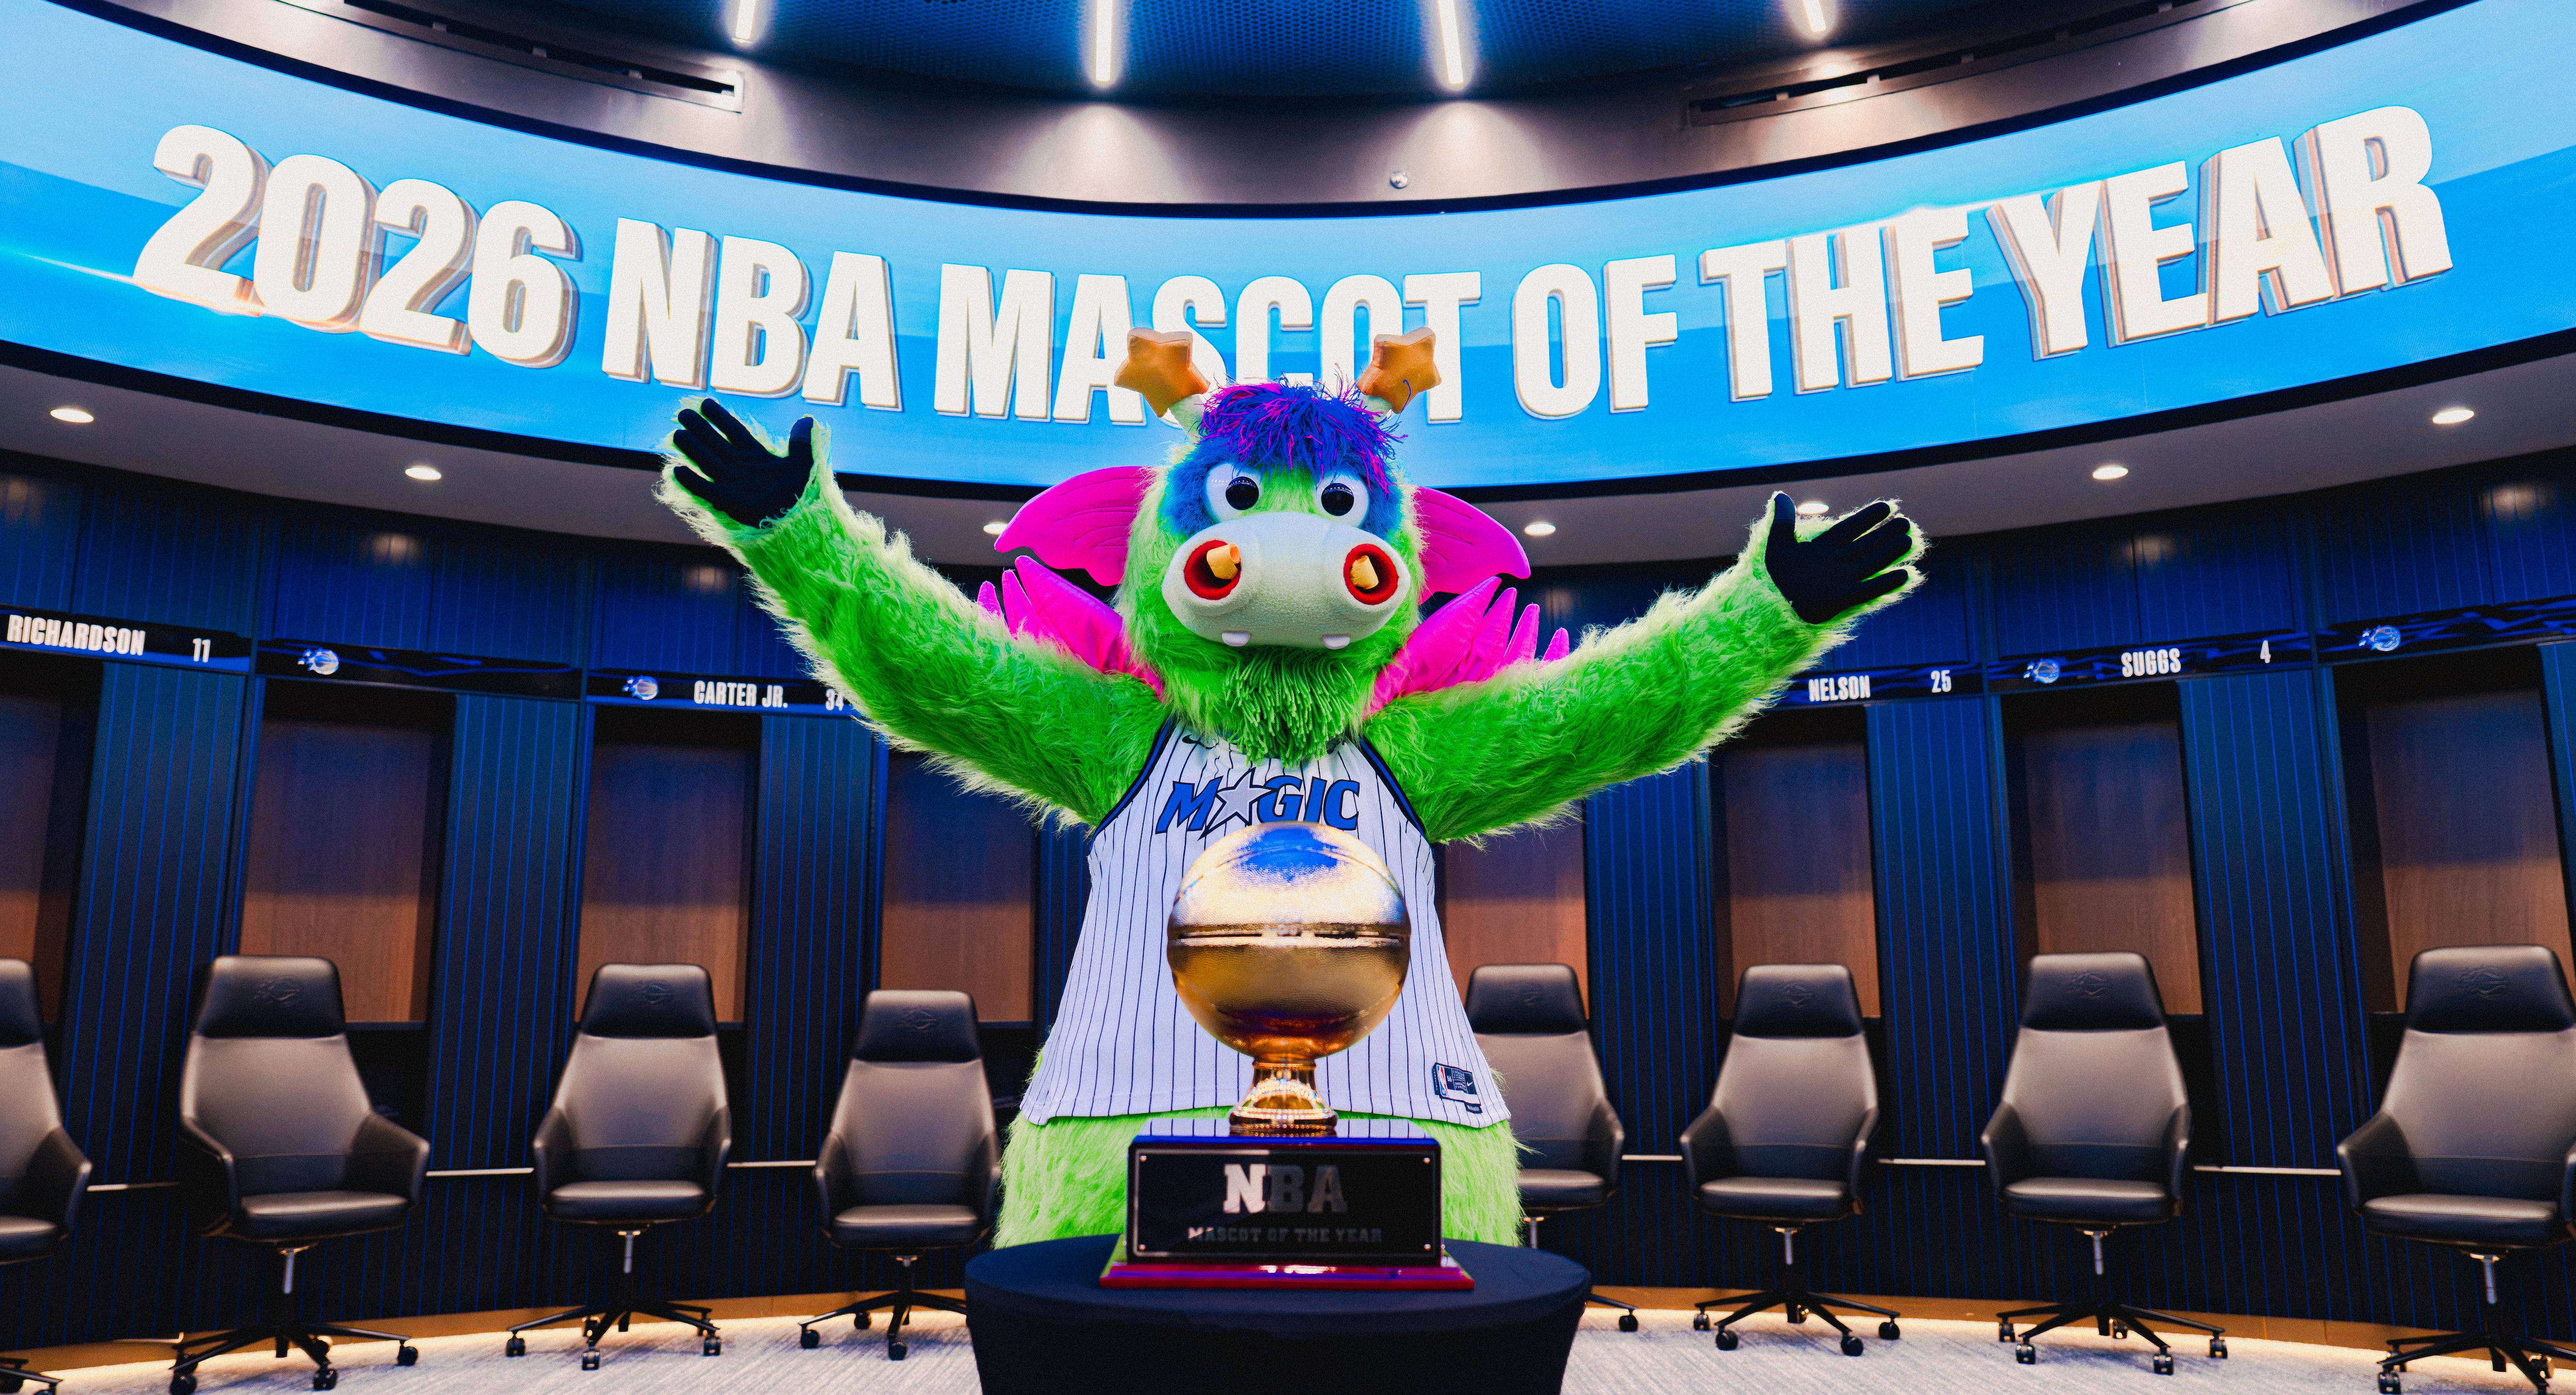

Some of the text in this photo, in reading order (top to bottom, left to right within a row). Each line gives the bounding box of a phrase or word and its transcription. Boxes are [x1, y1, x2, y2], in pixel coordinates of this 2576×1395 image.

[132, 105, 2453, 427] 2026 NBA MASCOT OF THE YEAR
[7, 614, 211, 663] RICHARDSON 11
[2121, 640, 2272, 677] SUGGS 4
[693, 680, 844, 711] CARTER JR. 34
[1808, 670, 1952, 702] NELSON 25
[1223, 1163, 1348, 1214] NBA
[1188, 1227, 1382, 1243] MASCOT OF THE YEAR
